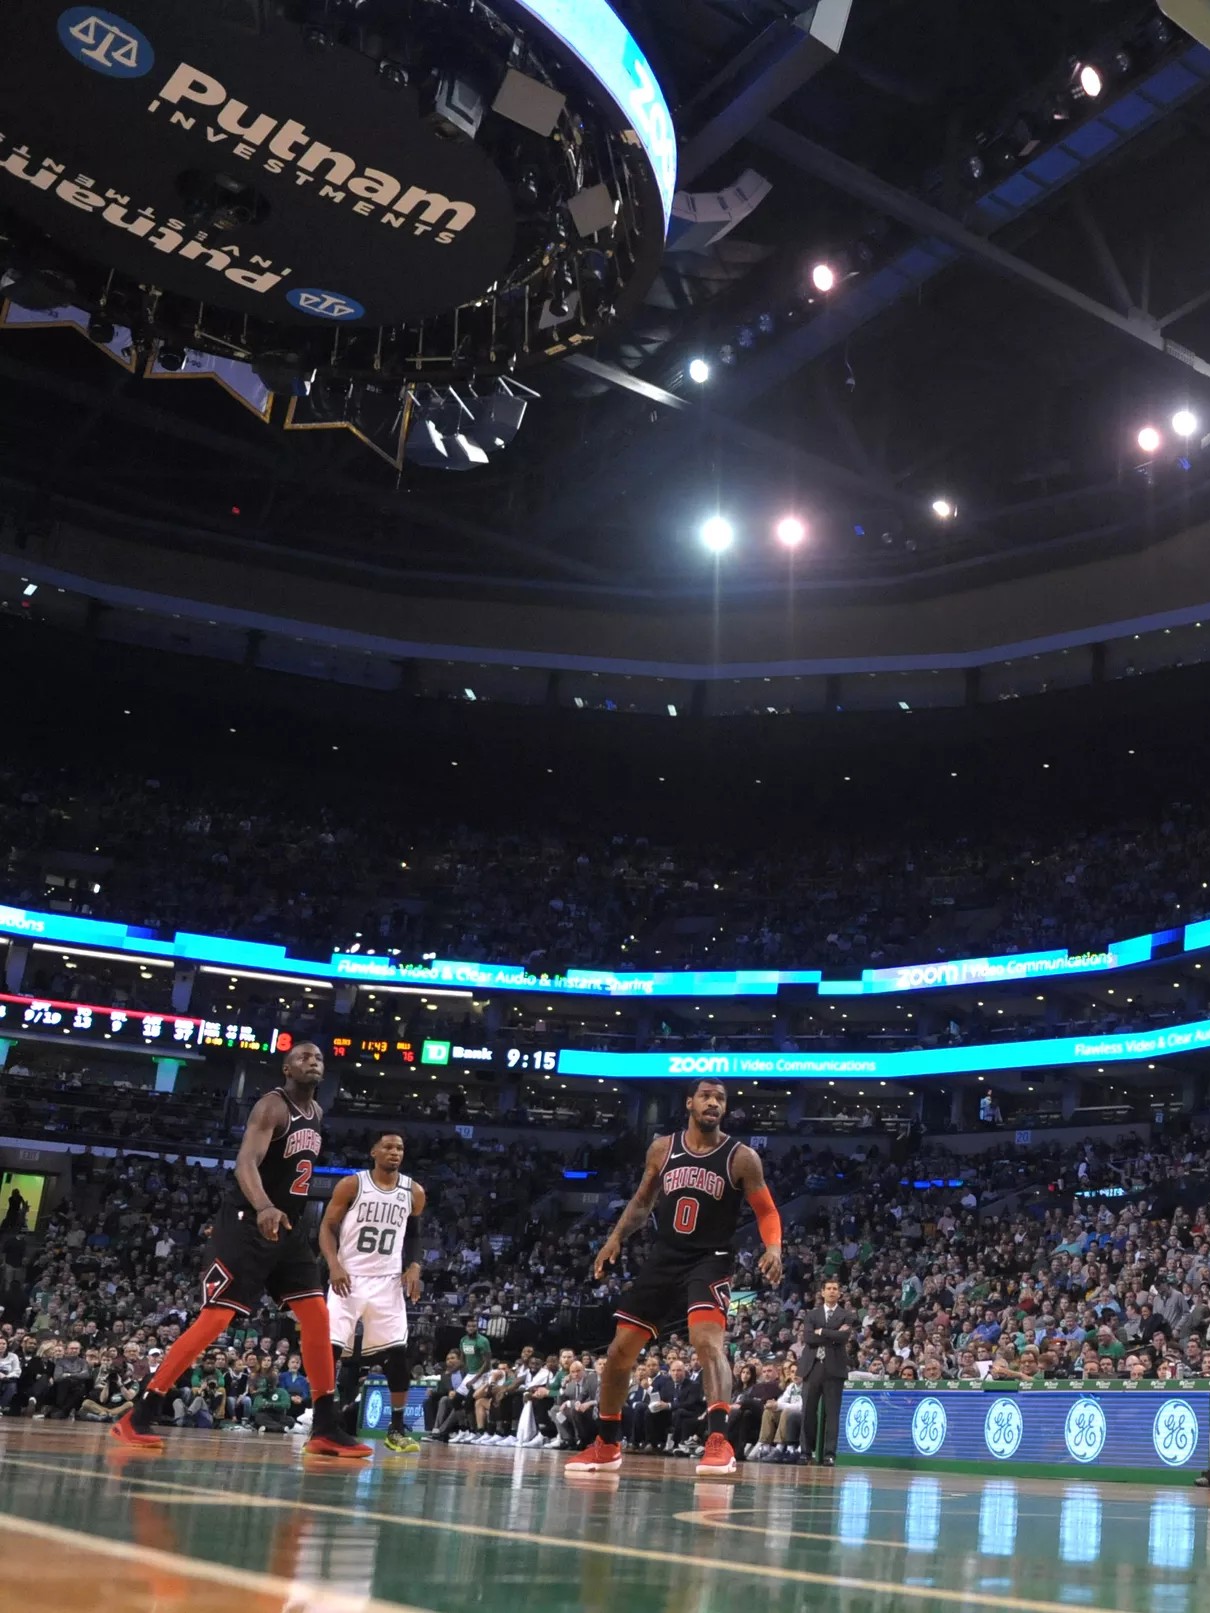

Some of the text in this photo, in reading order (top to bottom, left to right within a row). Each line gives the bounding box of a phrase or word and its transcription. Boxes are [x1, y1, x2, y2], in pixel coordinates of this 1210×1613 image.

[157, 63, 477, 232] Putnam
[147, 99, 455, 245] INVESTMENTS
[495, 971, 536, 986] Audio
[554, 975, 603, 990] Instant
[605, 978, 653, 993] Sharing
[896, 963, 957, 988] zoom
[1007, 952, 1113, 974] Communications
[427, 1043, 556, 1071] TD Bank 9:15
[1075, 1042, 1122, 1056] Flawless
[1125, 1039, 1155, 1052] Video
[1167, 1033, 1192, 1047] Clear
[669, 1056, 876, 1073] zoom Video Communications
[283, 1128, 322, 1158] CHICA
[290, 1159, 313, 1196] 2
[663, 1166, 725, 1201] CHICAGO
[356, 1201, 406, 1228] CELTICS
[673, 1196, 700, 1235] 0
[356, 1226, 397, 1256] 60
